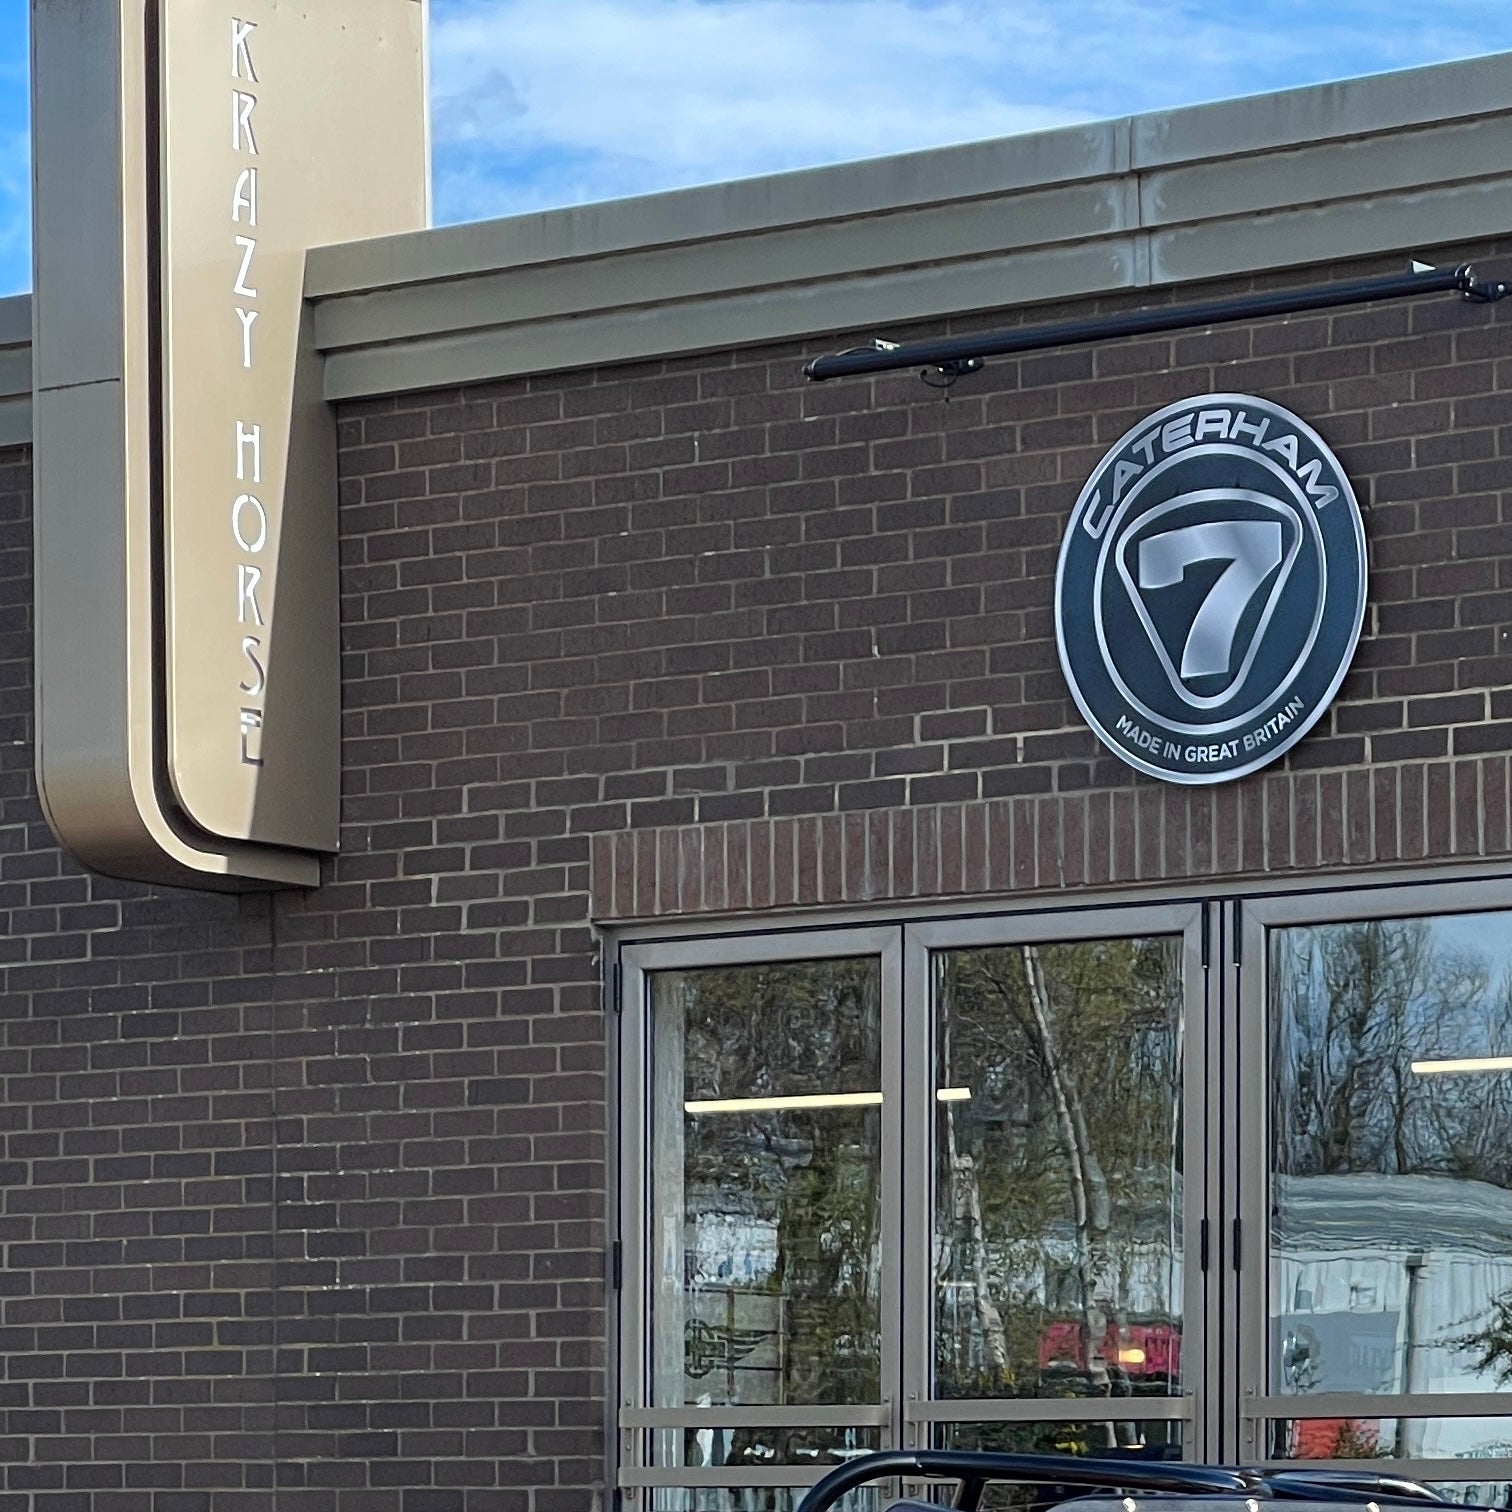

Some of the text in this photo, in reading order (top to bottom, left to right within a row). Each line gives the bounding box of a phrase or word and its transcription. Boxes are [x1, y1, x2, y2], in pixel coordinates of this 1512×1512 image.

[230, 16, 267, 767] KRAZY HORSE
[1082, 409, 1340, 540] CATERHAM
[1138, 520, 1283, 679] 7
[1115, 695, 1306, 763] MADE IN GREAT BRITAIN
